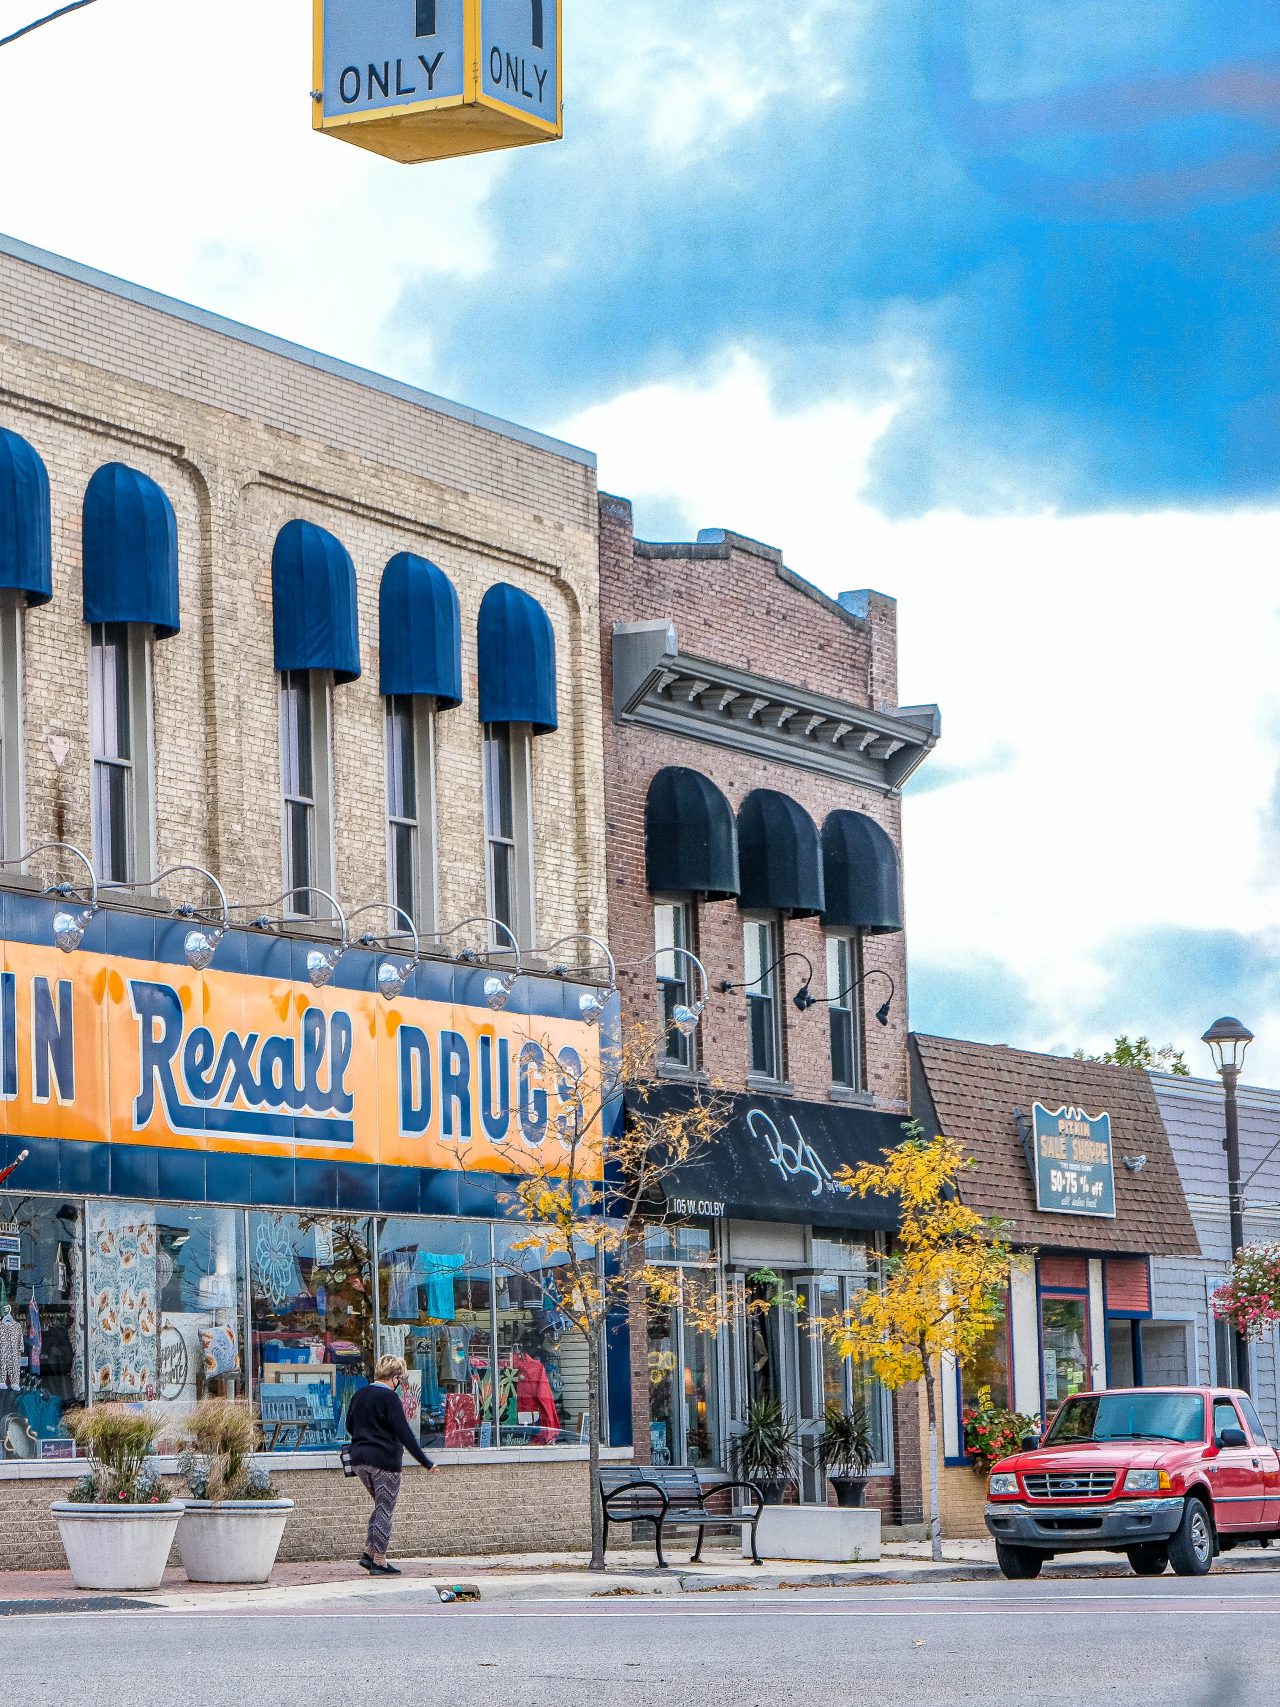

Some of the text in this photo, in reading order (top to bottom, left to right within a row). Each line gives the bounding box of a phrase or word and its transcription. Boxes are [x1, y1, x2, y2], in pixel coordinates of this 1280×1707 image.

[339, 51, 445, 104] ONLY
[490, 46, 548, 103] ONLY
[126, 979, 354, 1148] Rexall
[397, 1024, 585, 1152] DRUGS
[673, 1199, 725, 1217] 105 W. COLBY
